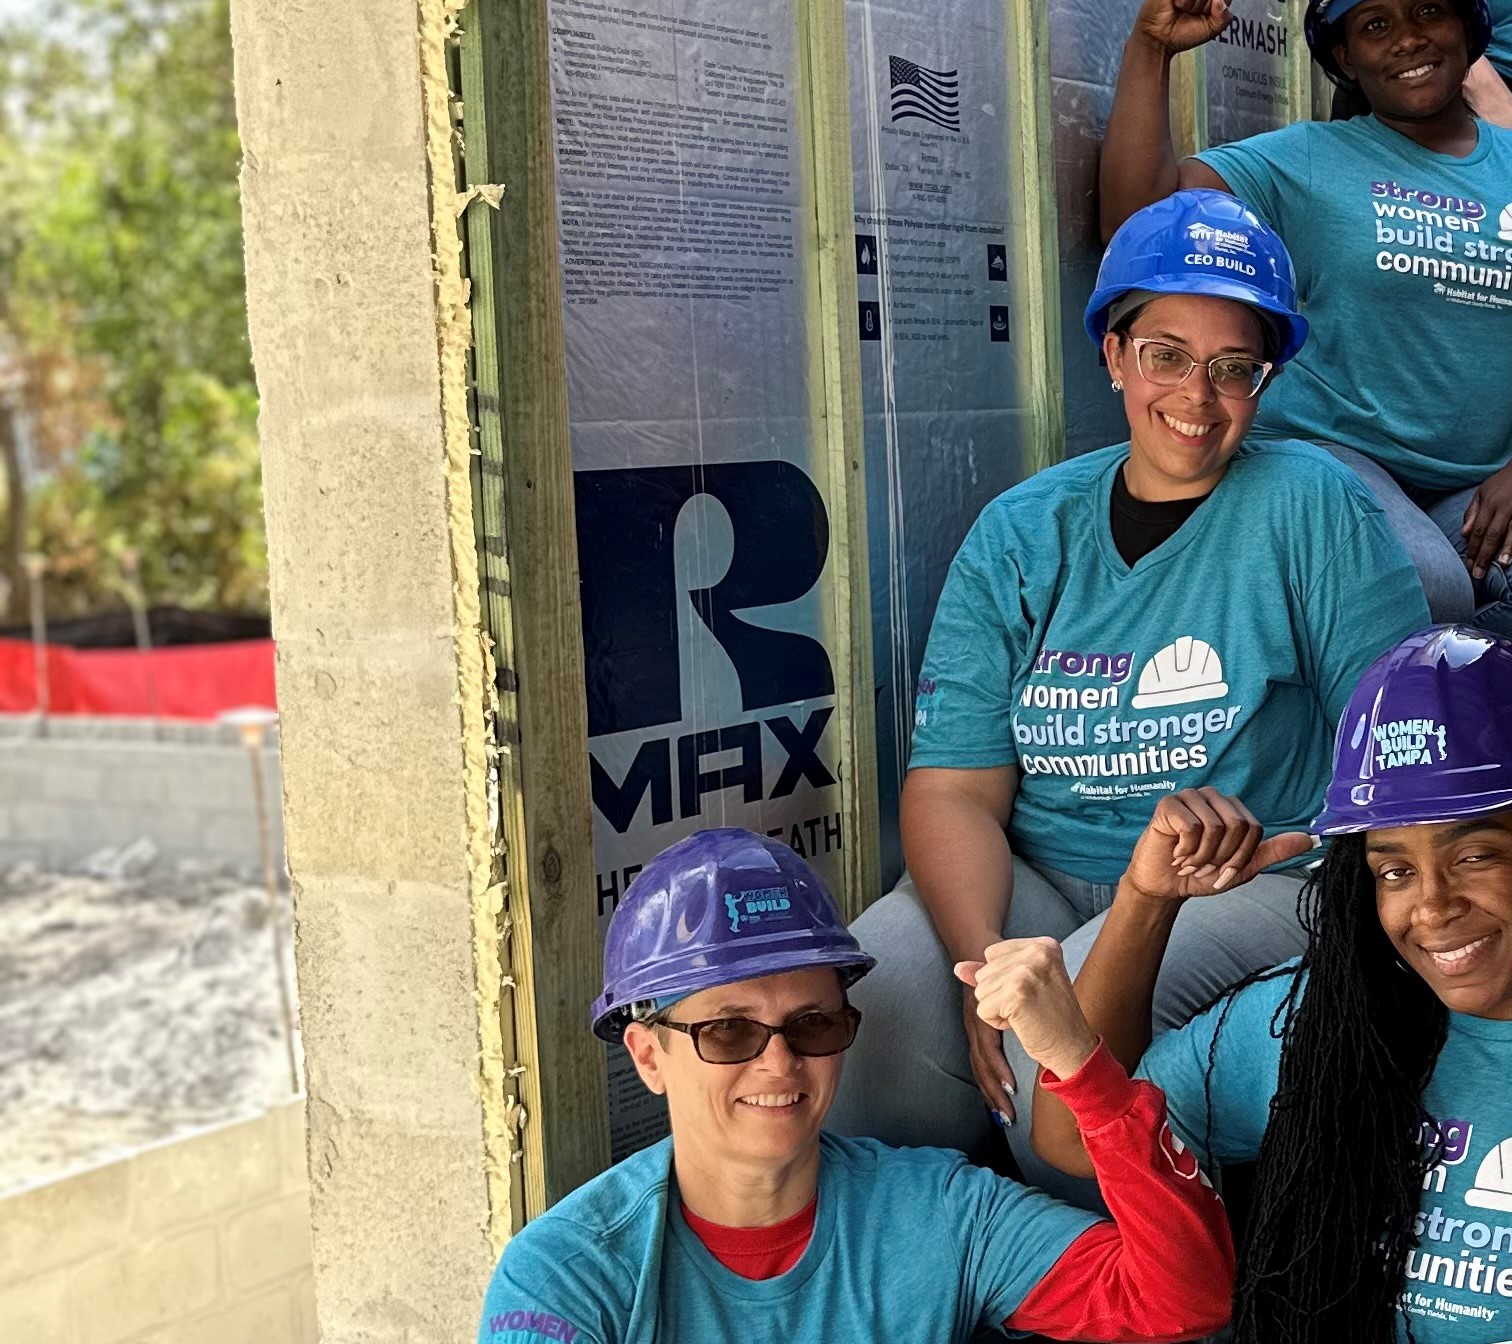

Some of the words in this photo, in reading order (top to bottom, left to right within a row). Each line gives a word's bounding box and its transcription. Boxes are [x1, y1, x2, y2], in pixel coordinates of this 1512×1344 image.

[1222, 64, 1267, 86] CONTINUOUS
[1371, 181, 1486, 221] strong
[1372, 202, 1480, 233] women
[1215, 228, 1248, 244] Habitat
[1376, 219, 1454, 255] build
[1184, 254, 1213, 265] CEO
[1216, 256, 1255, 276] BUILD
[1446, 287, 1475, 301] Habitat
[1034, 649, 1136, 685] trong
[1018, 683, 1118, 710] women
[1012, 712, 1085, 746] build
[1093, 705, 1241, 744] stronger
[1372, 718, 1434, 742] WOMEN
[1380, 733, 1426, 754] BUILD
[588, 706, 837, 834] MAX
[1021, 741, 1209, 778] communities
[1375, 749, 1432, 770] TAMPA
[1130, 780, 1176, 793] Humanity
[745, 899, 791, 914] BUILD
[1415, 1293, 1434, 1307] for
[1434, 1297, 1496, 1322] Humanity
[489, 1309, 579, 1344] WOMEN
